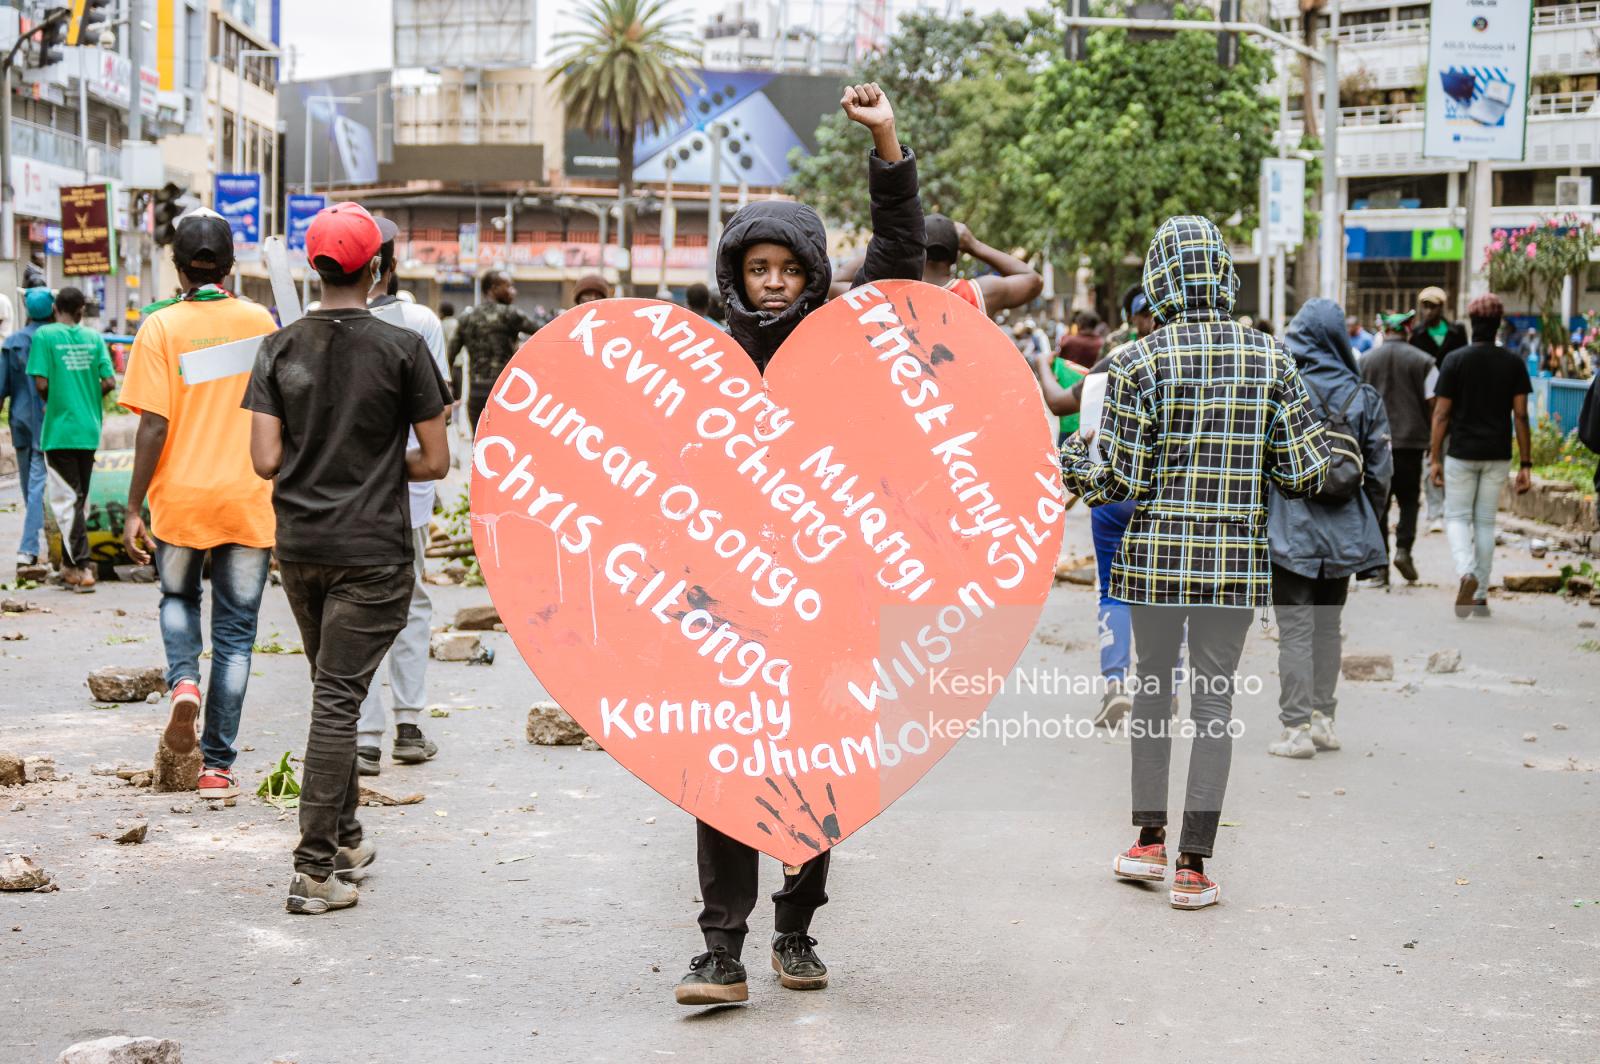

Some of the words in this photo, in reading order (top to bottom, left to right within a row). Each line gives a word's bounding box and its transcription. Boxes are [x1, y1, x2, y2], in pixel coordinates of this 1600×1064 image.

[569, 308, 686, 418] Kevin
[696, 407, 847, 563] Ochieng
[633, 304, 794, 442] Anthony
[800, 445, 935, 601] Mwangi
[842, 284, 954, 434] Ernest
[473, 435, 602, 553] Chris
[604, 542, 792, 697] Gitonga
[494, 367, 657, 497] Duncan
[660, 484, 822, 621] Osongo
[600, 691, 791, 741] Kennedy
[848, 580, 996, 713] Wilson
